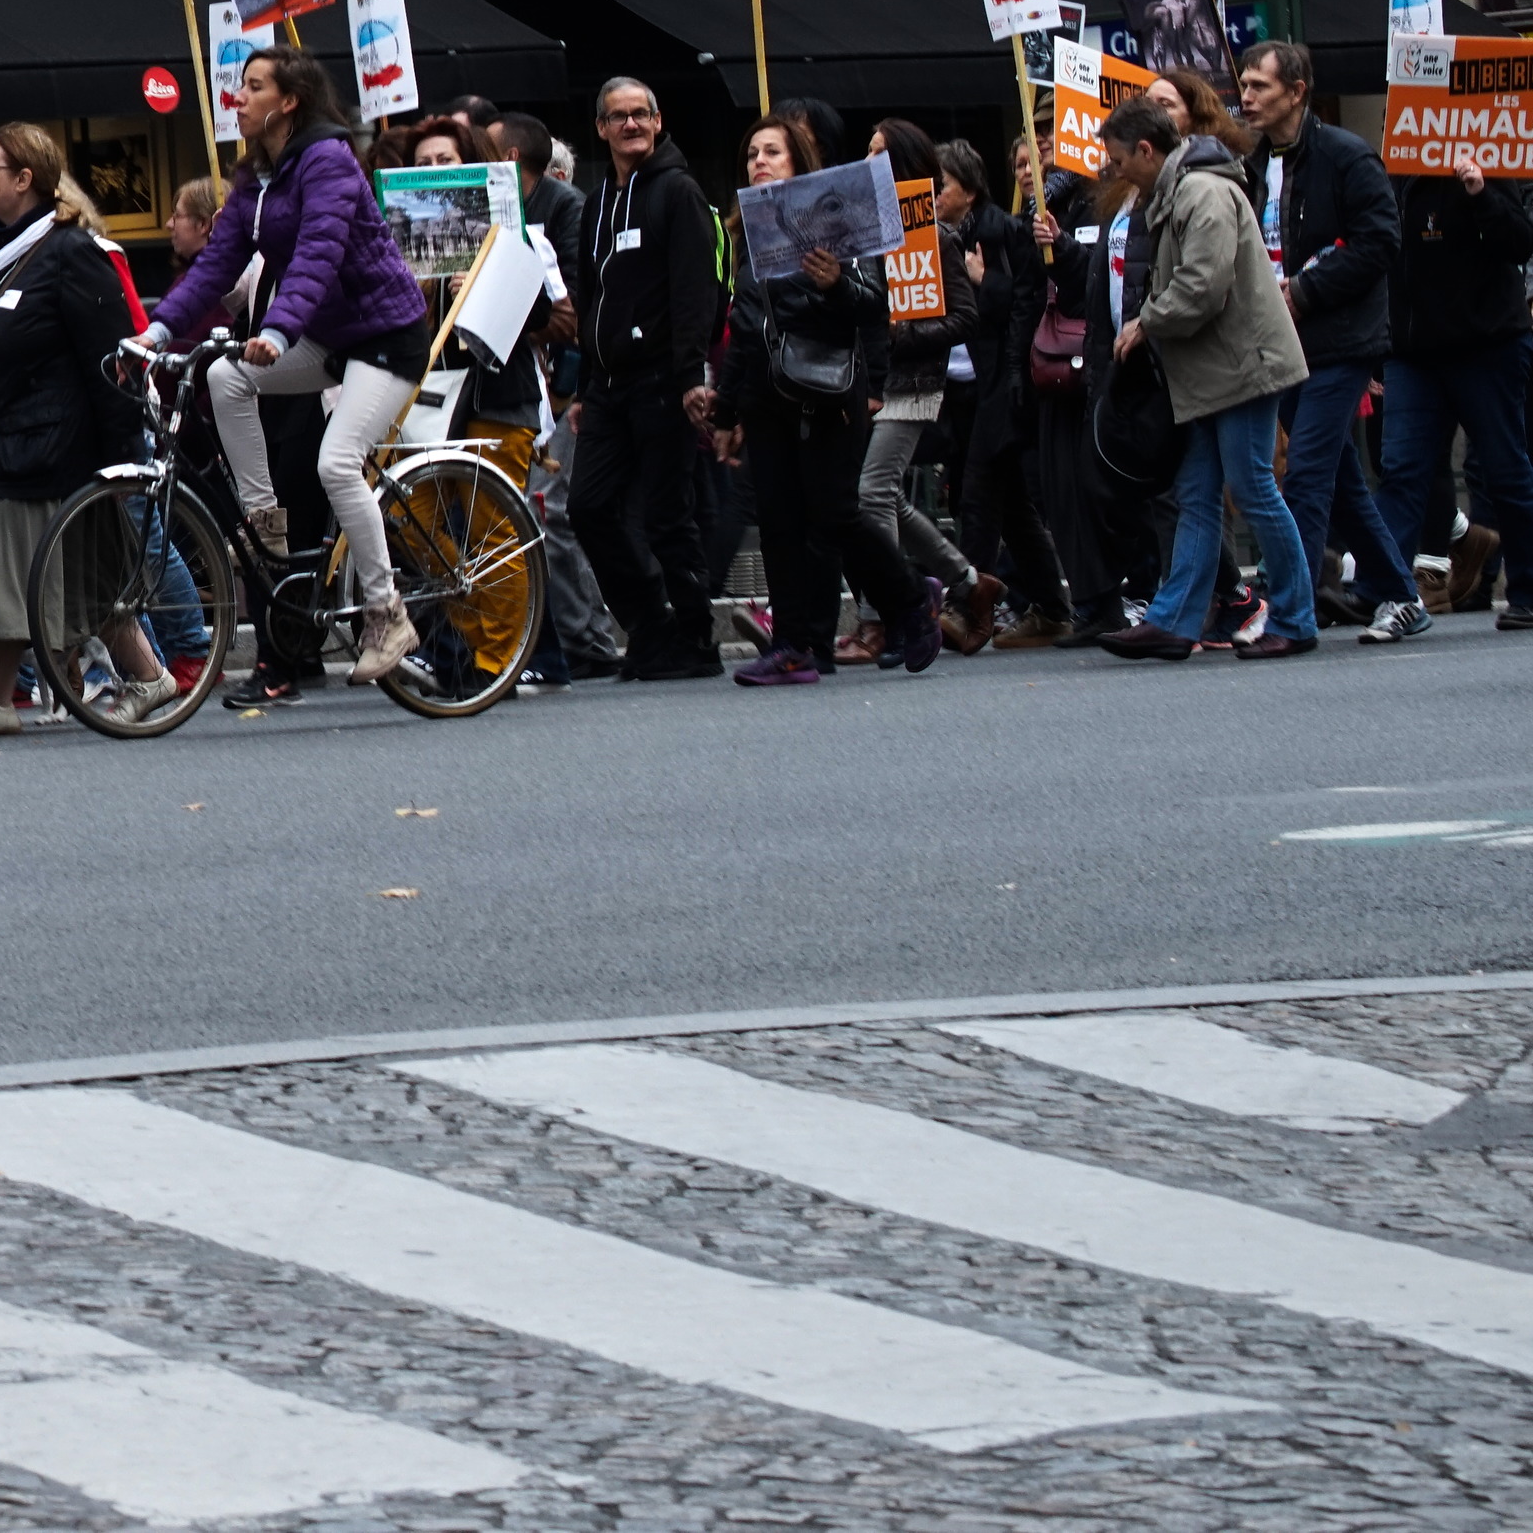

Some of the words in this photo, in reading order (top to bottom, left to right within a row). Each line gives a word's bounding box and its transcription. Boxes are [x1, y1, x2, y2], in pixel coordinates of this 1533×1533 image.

[1424, 55, 1438, 64] one
[1079, 64, 1090, 73] one
[1423, 66, 1443, 76] voice
[1079, 74, 1095, 86] voice
[1453, 61, 1533, 91] LIBER
[144, 78, 177, 99] Leica
[1494, 95, 1519, 107] LES
[1392, 107, 1533, 140] ANIMAU
[1060, 142, 1081, 158] DES
[1390, 147, 1417, 159] DES
[1421, 141, 1533, 169] CIRQUE
